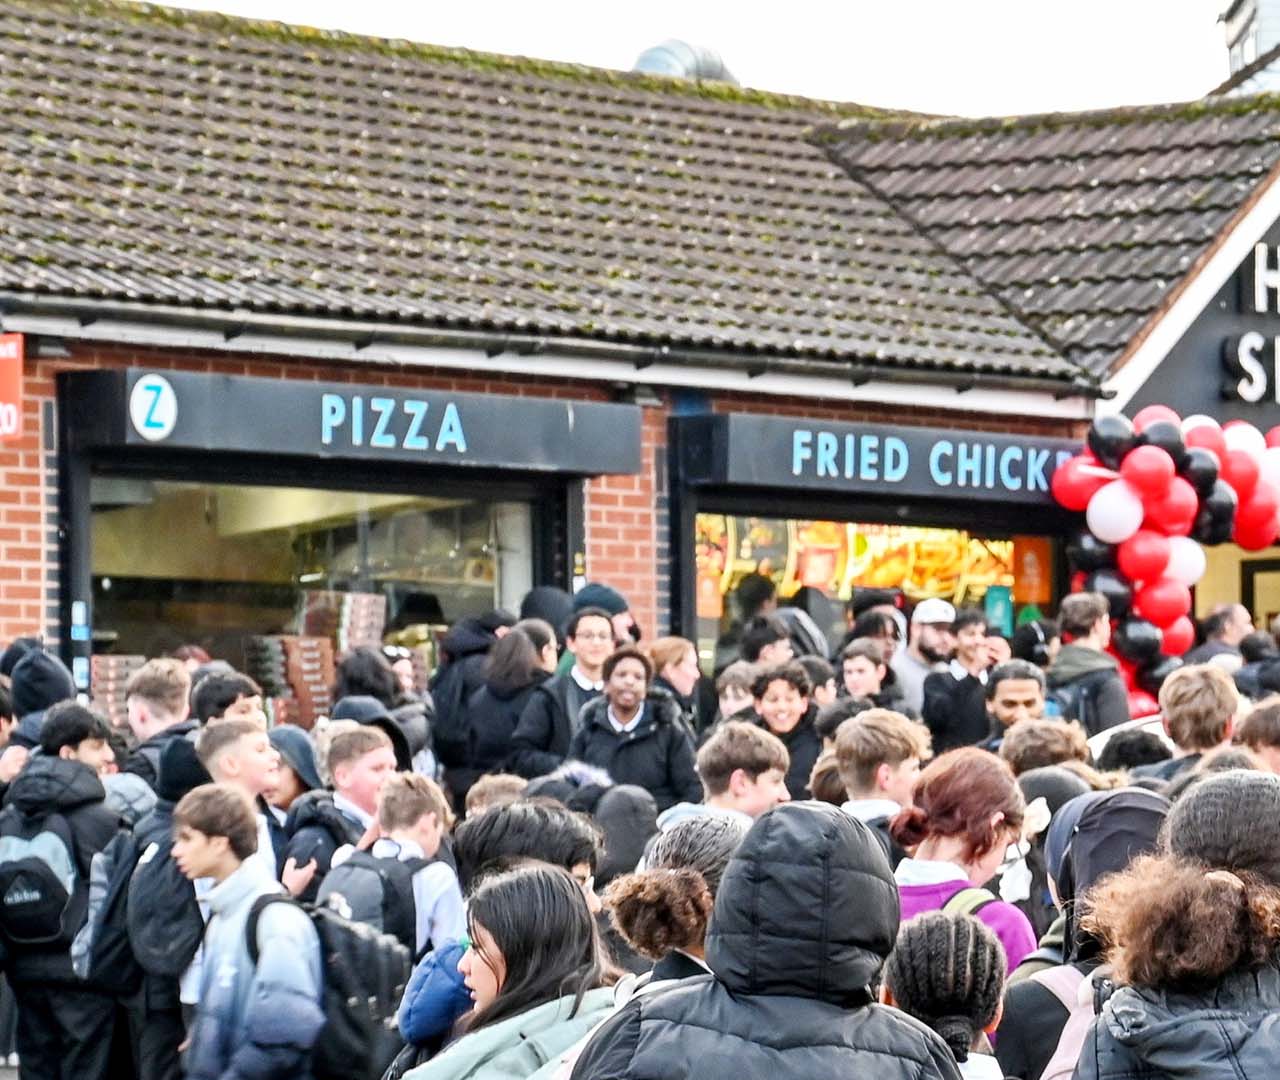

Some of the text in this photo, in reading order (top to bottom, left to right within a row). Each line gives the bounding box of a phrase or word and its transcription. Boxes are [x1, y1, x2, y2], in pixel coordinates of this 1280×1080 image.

[144, 385, 165, 428] Z
[322, 393, 467, 453] PIZZA
[792, 430, 909, 482] FRIED
